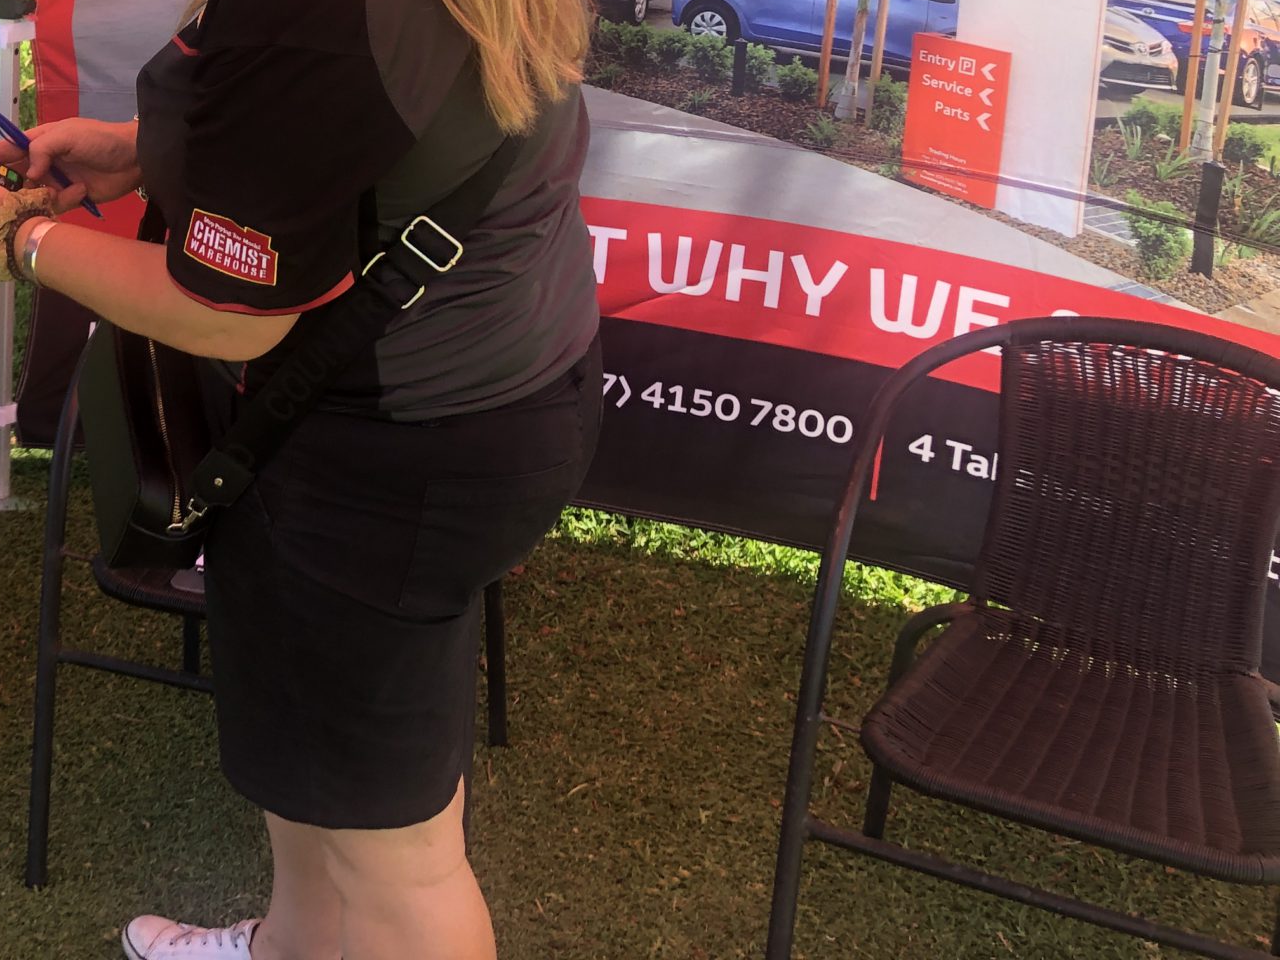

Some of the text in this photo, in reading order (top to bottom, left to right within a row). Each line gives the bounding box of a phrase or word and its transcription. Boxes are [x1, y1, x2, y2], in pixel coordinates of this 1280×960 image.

[919, 49, 956, 72] Entry
[921, 73, 973, 98] Service
[934, 100, 970, 122] Parts
[190, 238, 267, 279] WAREHOUSE
[193, 220, 271, 269] CHEMIST
[647, 232, 849, 317] WHY
[869, 267, 1011, 357] WE
[640, 381, 741, 422] 4150
[750, 398, 854, 444] 7800
[908, 434, 935, 462] 4
